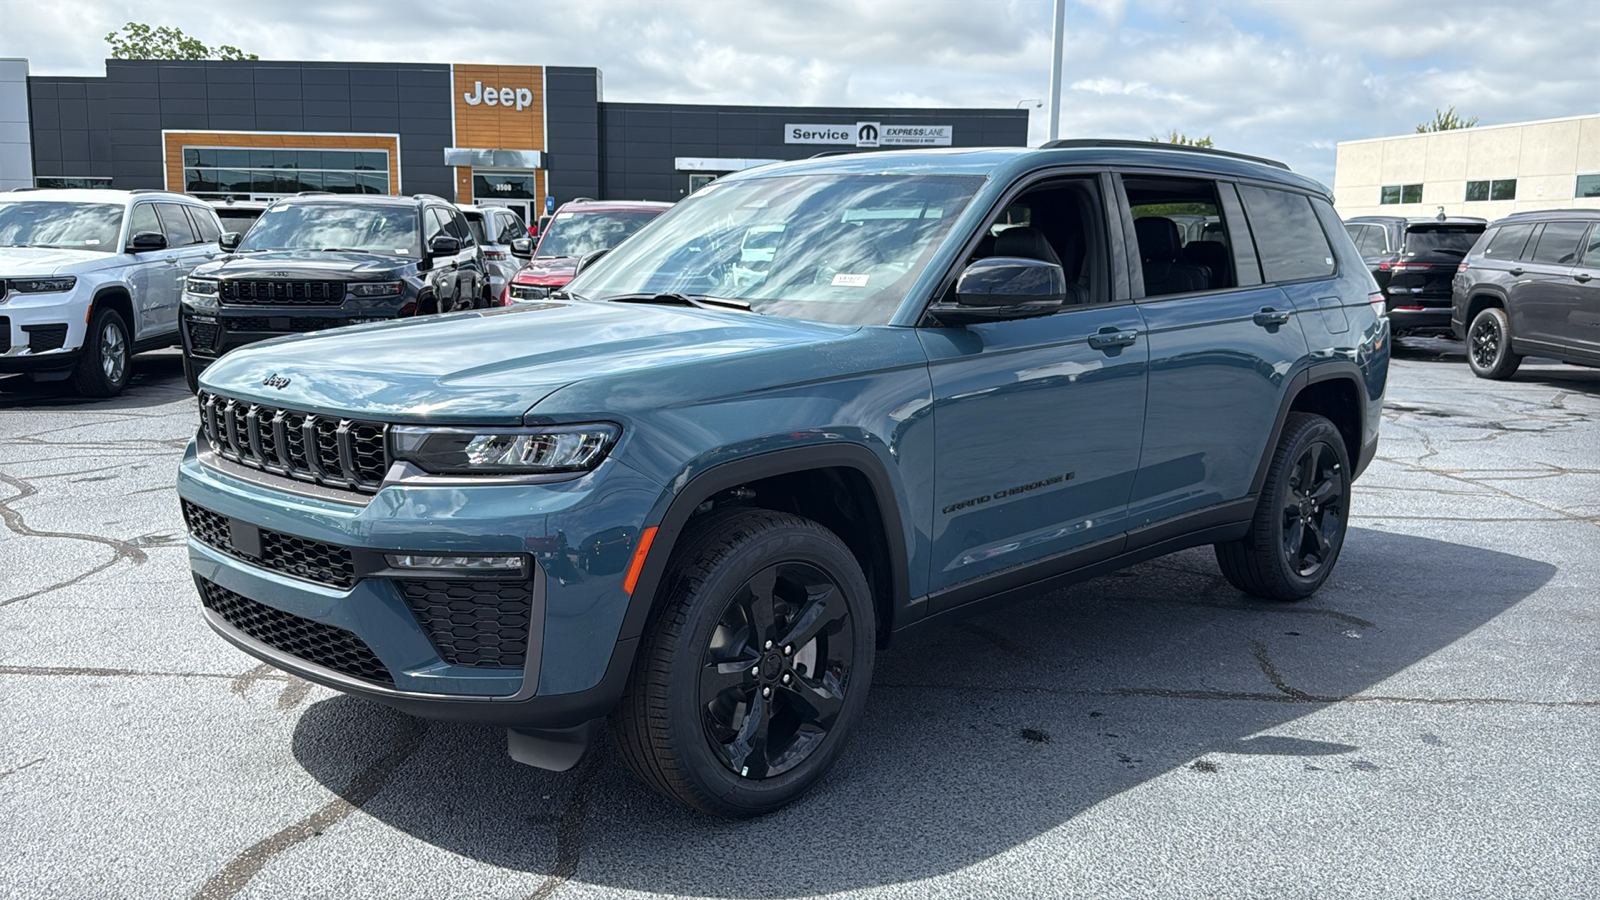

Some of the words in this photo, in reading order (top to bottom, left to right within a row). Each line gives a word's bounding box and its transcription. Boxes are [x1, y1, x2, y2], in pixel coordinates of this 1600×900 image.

[464, 81, 533, 111] Jeep
[792, 128, 849, 140] Service
[263, 373, 291, 390] Jeep
[942, 495, 991, 514] GRAND
[993, 475, 1063, 499] CHEROKEE
